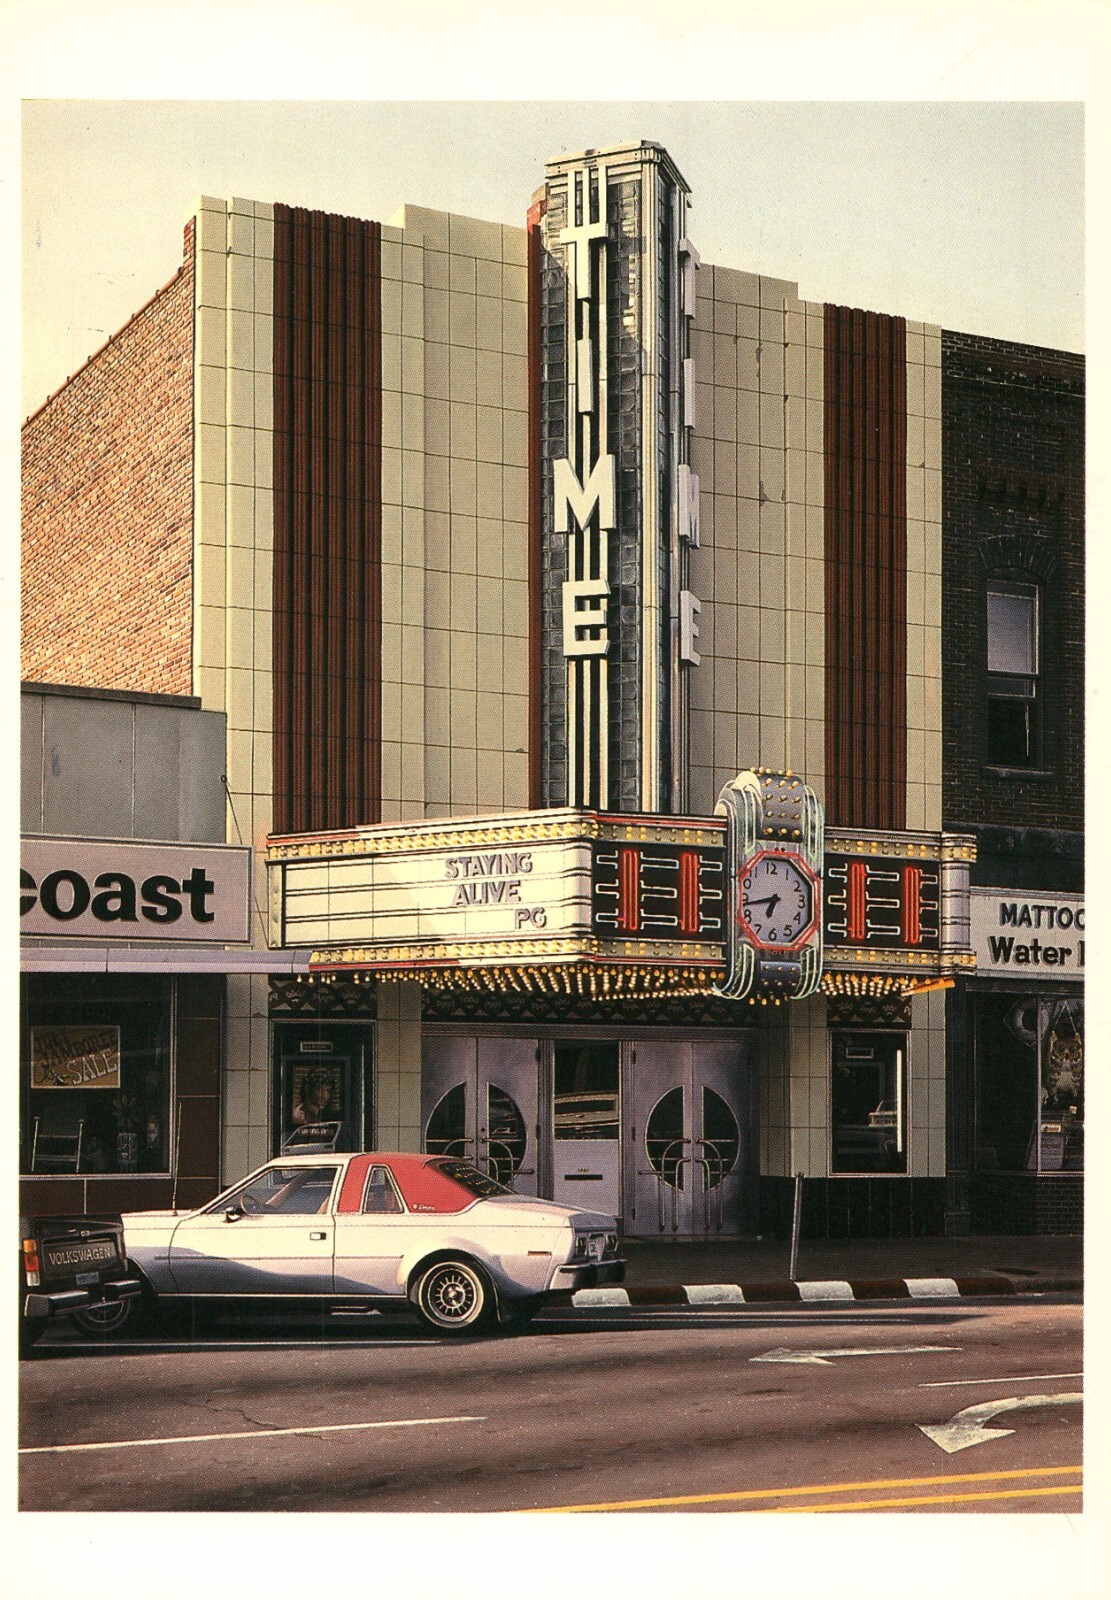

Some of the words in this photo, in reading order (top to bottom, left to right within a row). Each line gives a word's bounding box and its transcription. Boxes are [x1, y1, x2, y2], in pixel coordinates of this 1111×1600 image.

[553, 220, 616, 657] TIME
[445, 852, 533, 878] STAYING
[766, 862, 778, 875] 12
[452, 880, 522, 906] ALIVE
[794, 881, 801, 892] 2
[798, 895, 805, 909] 3
[514, 906, 547, 930] PG
[744, 909, 752, 924] 8
[794, 912, 801, 925] 4
[755, 924, 762, 935] 7
[769, 928, 777, 941] 6
[783, 925, 793, 937] 5
[987, 935, 1073, 966] Water
[66, 1048, 118, 1085] SALE
[49, 1247, 111, 1265] VOLKSWAGEN
